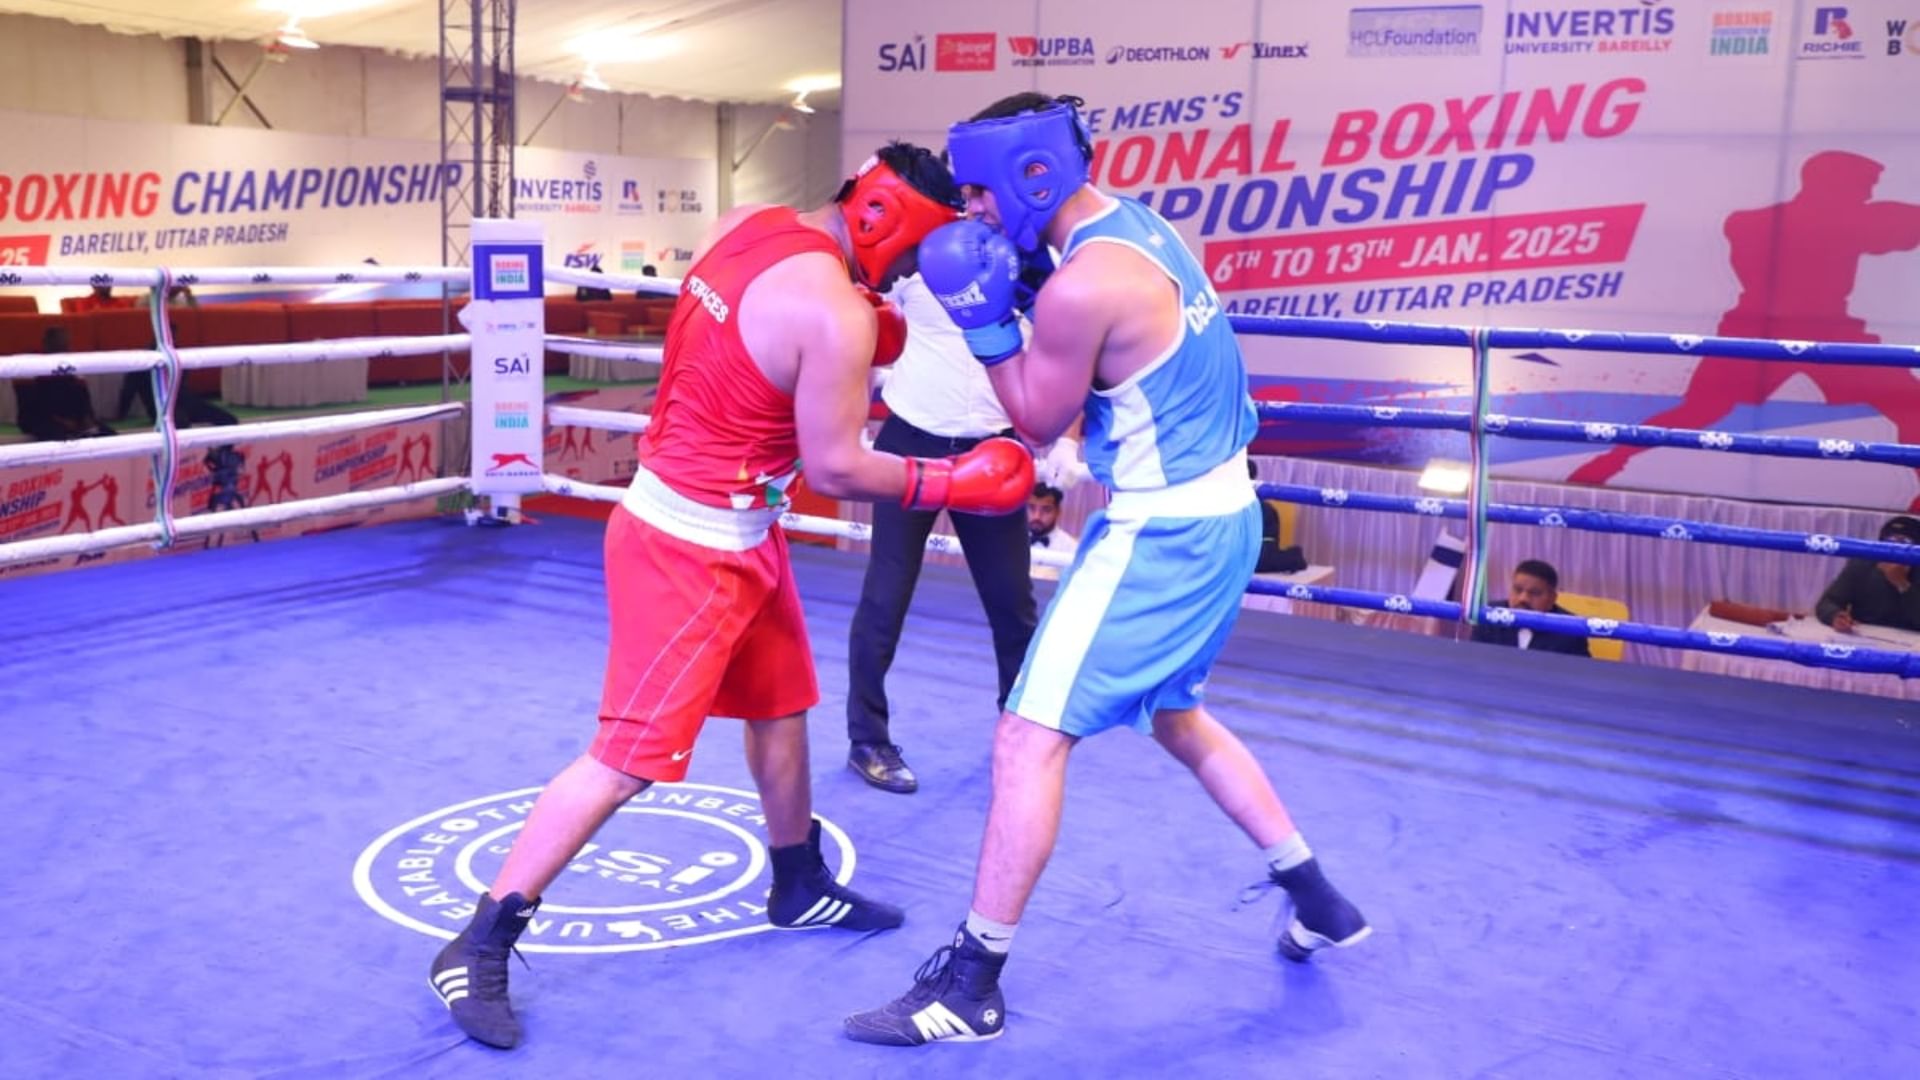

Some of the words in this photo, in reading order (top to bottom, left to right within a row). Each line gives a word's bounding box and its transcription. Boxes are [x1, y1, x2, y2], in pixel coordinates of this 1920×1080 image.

[1505, 8, 1675, 38] INVERTIS
[878, 33, 927, 72] SAI
[1038, 37, 1095, 57] UPBA
[1126, 47, 1210, 62] DECATHLON
[1504, 41, 1593, 55] UNIVERSITY
[1597, 40, 1672, 54] BAREILLY
[1710, 37, 1769, 56] INDIA
[1803, 41, 1863, 54] RICHIE
[1321, 78, 1647, 168] BOXING
[172, 163, 463, 216] CHAMPIONSHIP
[61, 231, 149, 257] BAREILLY,
[155, 227, 209, 251] UTTAR
[214, 222, 288, 247] PRADESH
[1213, 249, 1263, 284] 6TH
[1272, 248, 1314, 279] TO
[1326, 238, 1394, 275] 13TH
[1399, 231, 1490, 269] JAN.
[1501, 221, 1604, 261] 2025
[1352, 282, 1450, 315] UTTAR
[1460, 271, 1625, 307] PRADESH
[494, 354, 530, 375] SAI
[495, 416, 529, 429] INDIA
